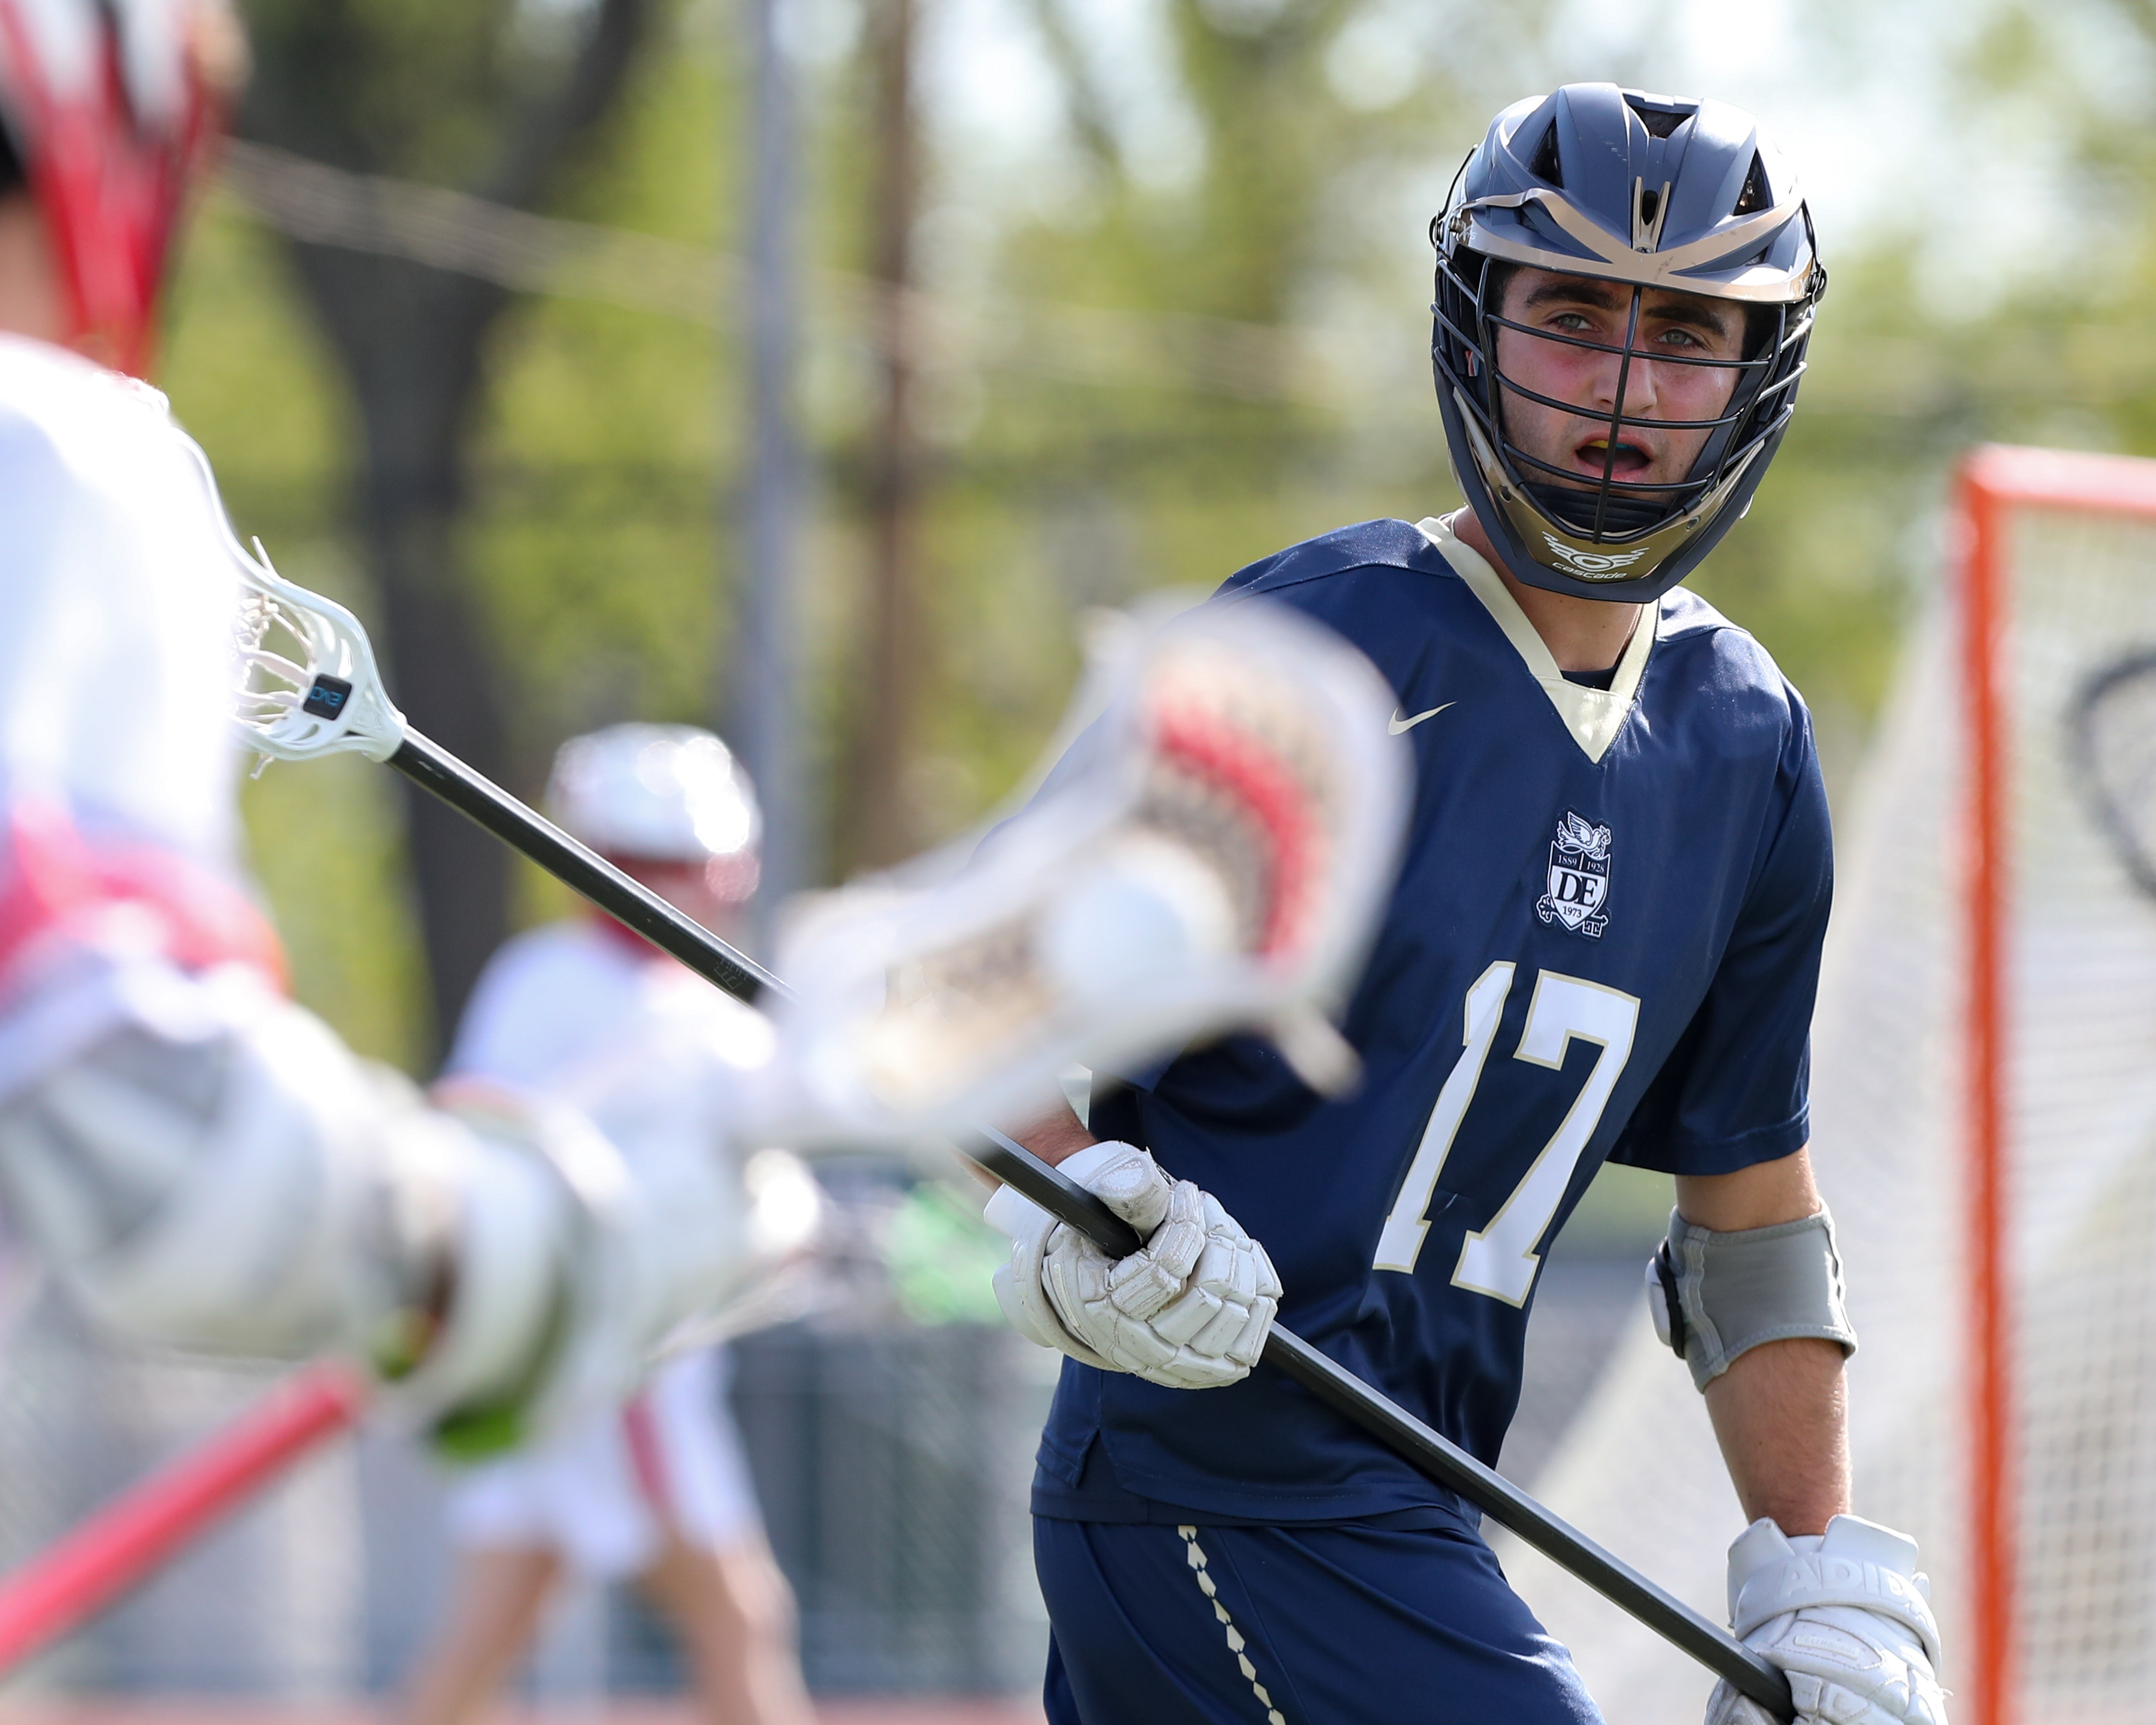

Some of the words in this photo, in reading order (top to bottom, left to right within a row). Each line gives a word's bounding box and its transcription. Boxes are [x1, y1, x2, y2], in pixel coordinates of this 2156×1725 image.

[1552, 562, 1627, 579] cascade
[1558, 855, 1577, 865] 1889
[1587, 861, 1605, 872] 1928
[1555, 871, 1598, 907] DE
[1563, 906, 1582, 918] 1973
[1372, 960, 1641, 1309] 17
